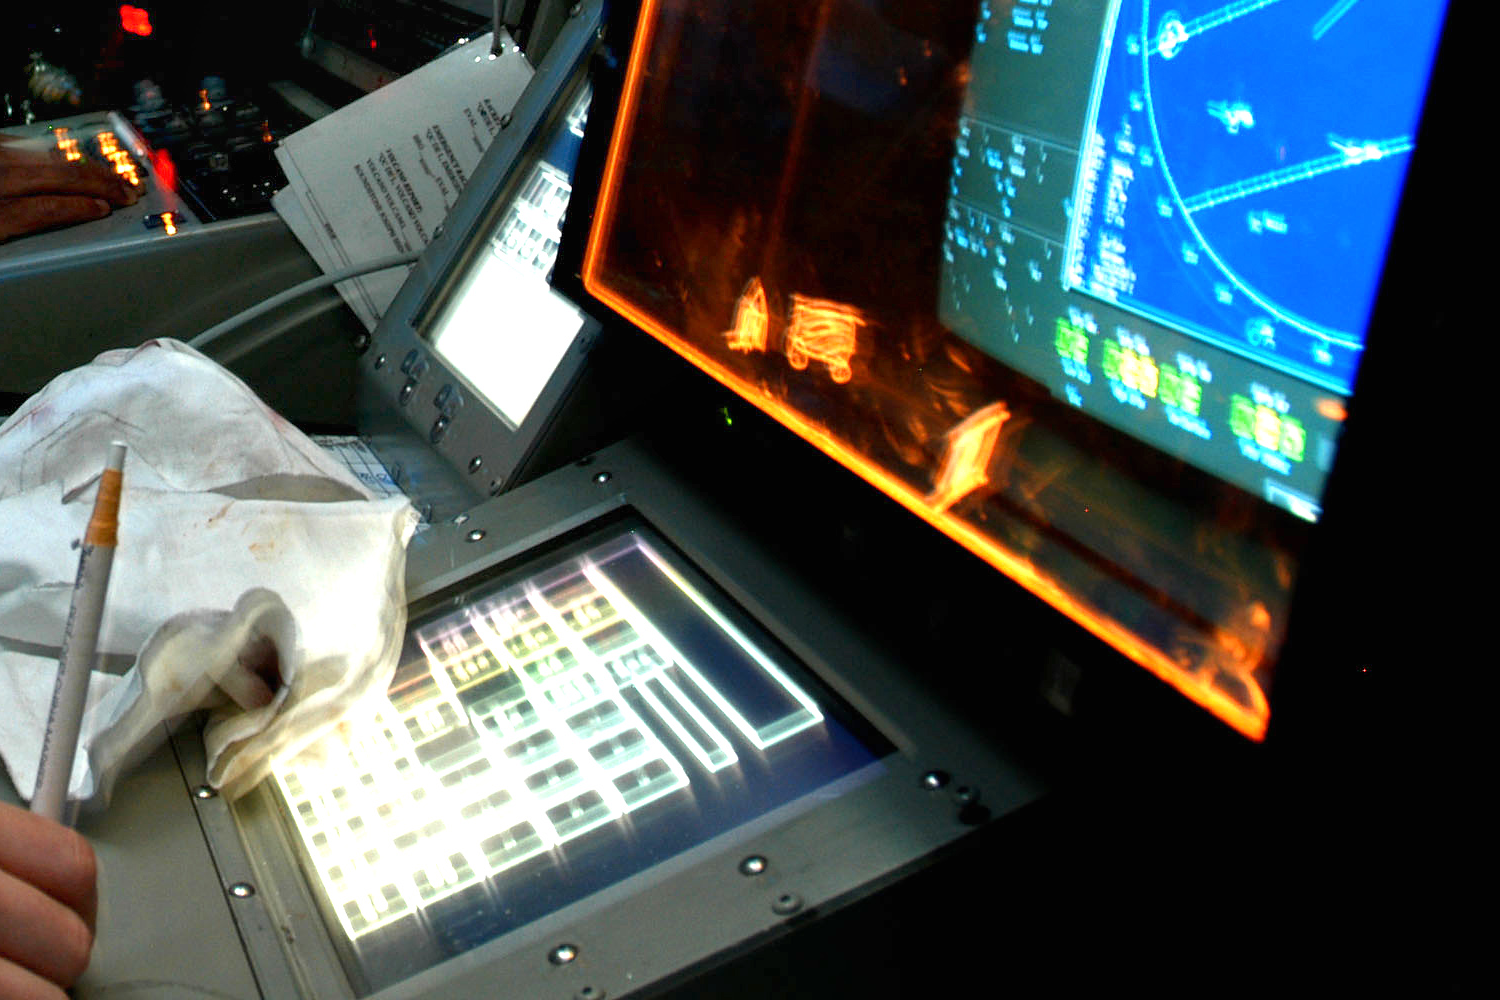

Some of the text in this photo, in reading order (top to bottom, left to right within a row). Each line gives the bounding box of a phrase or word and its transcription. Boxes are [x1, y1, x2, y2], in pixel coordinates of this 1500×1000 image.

[432, 125, 459, 168] EMERGENCY
[365, 158, 387, 192] VOLCANO
[385, 149, 407, 182] VOLCANO
[394, 184, 417, 219] VOLCANO
